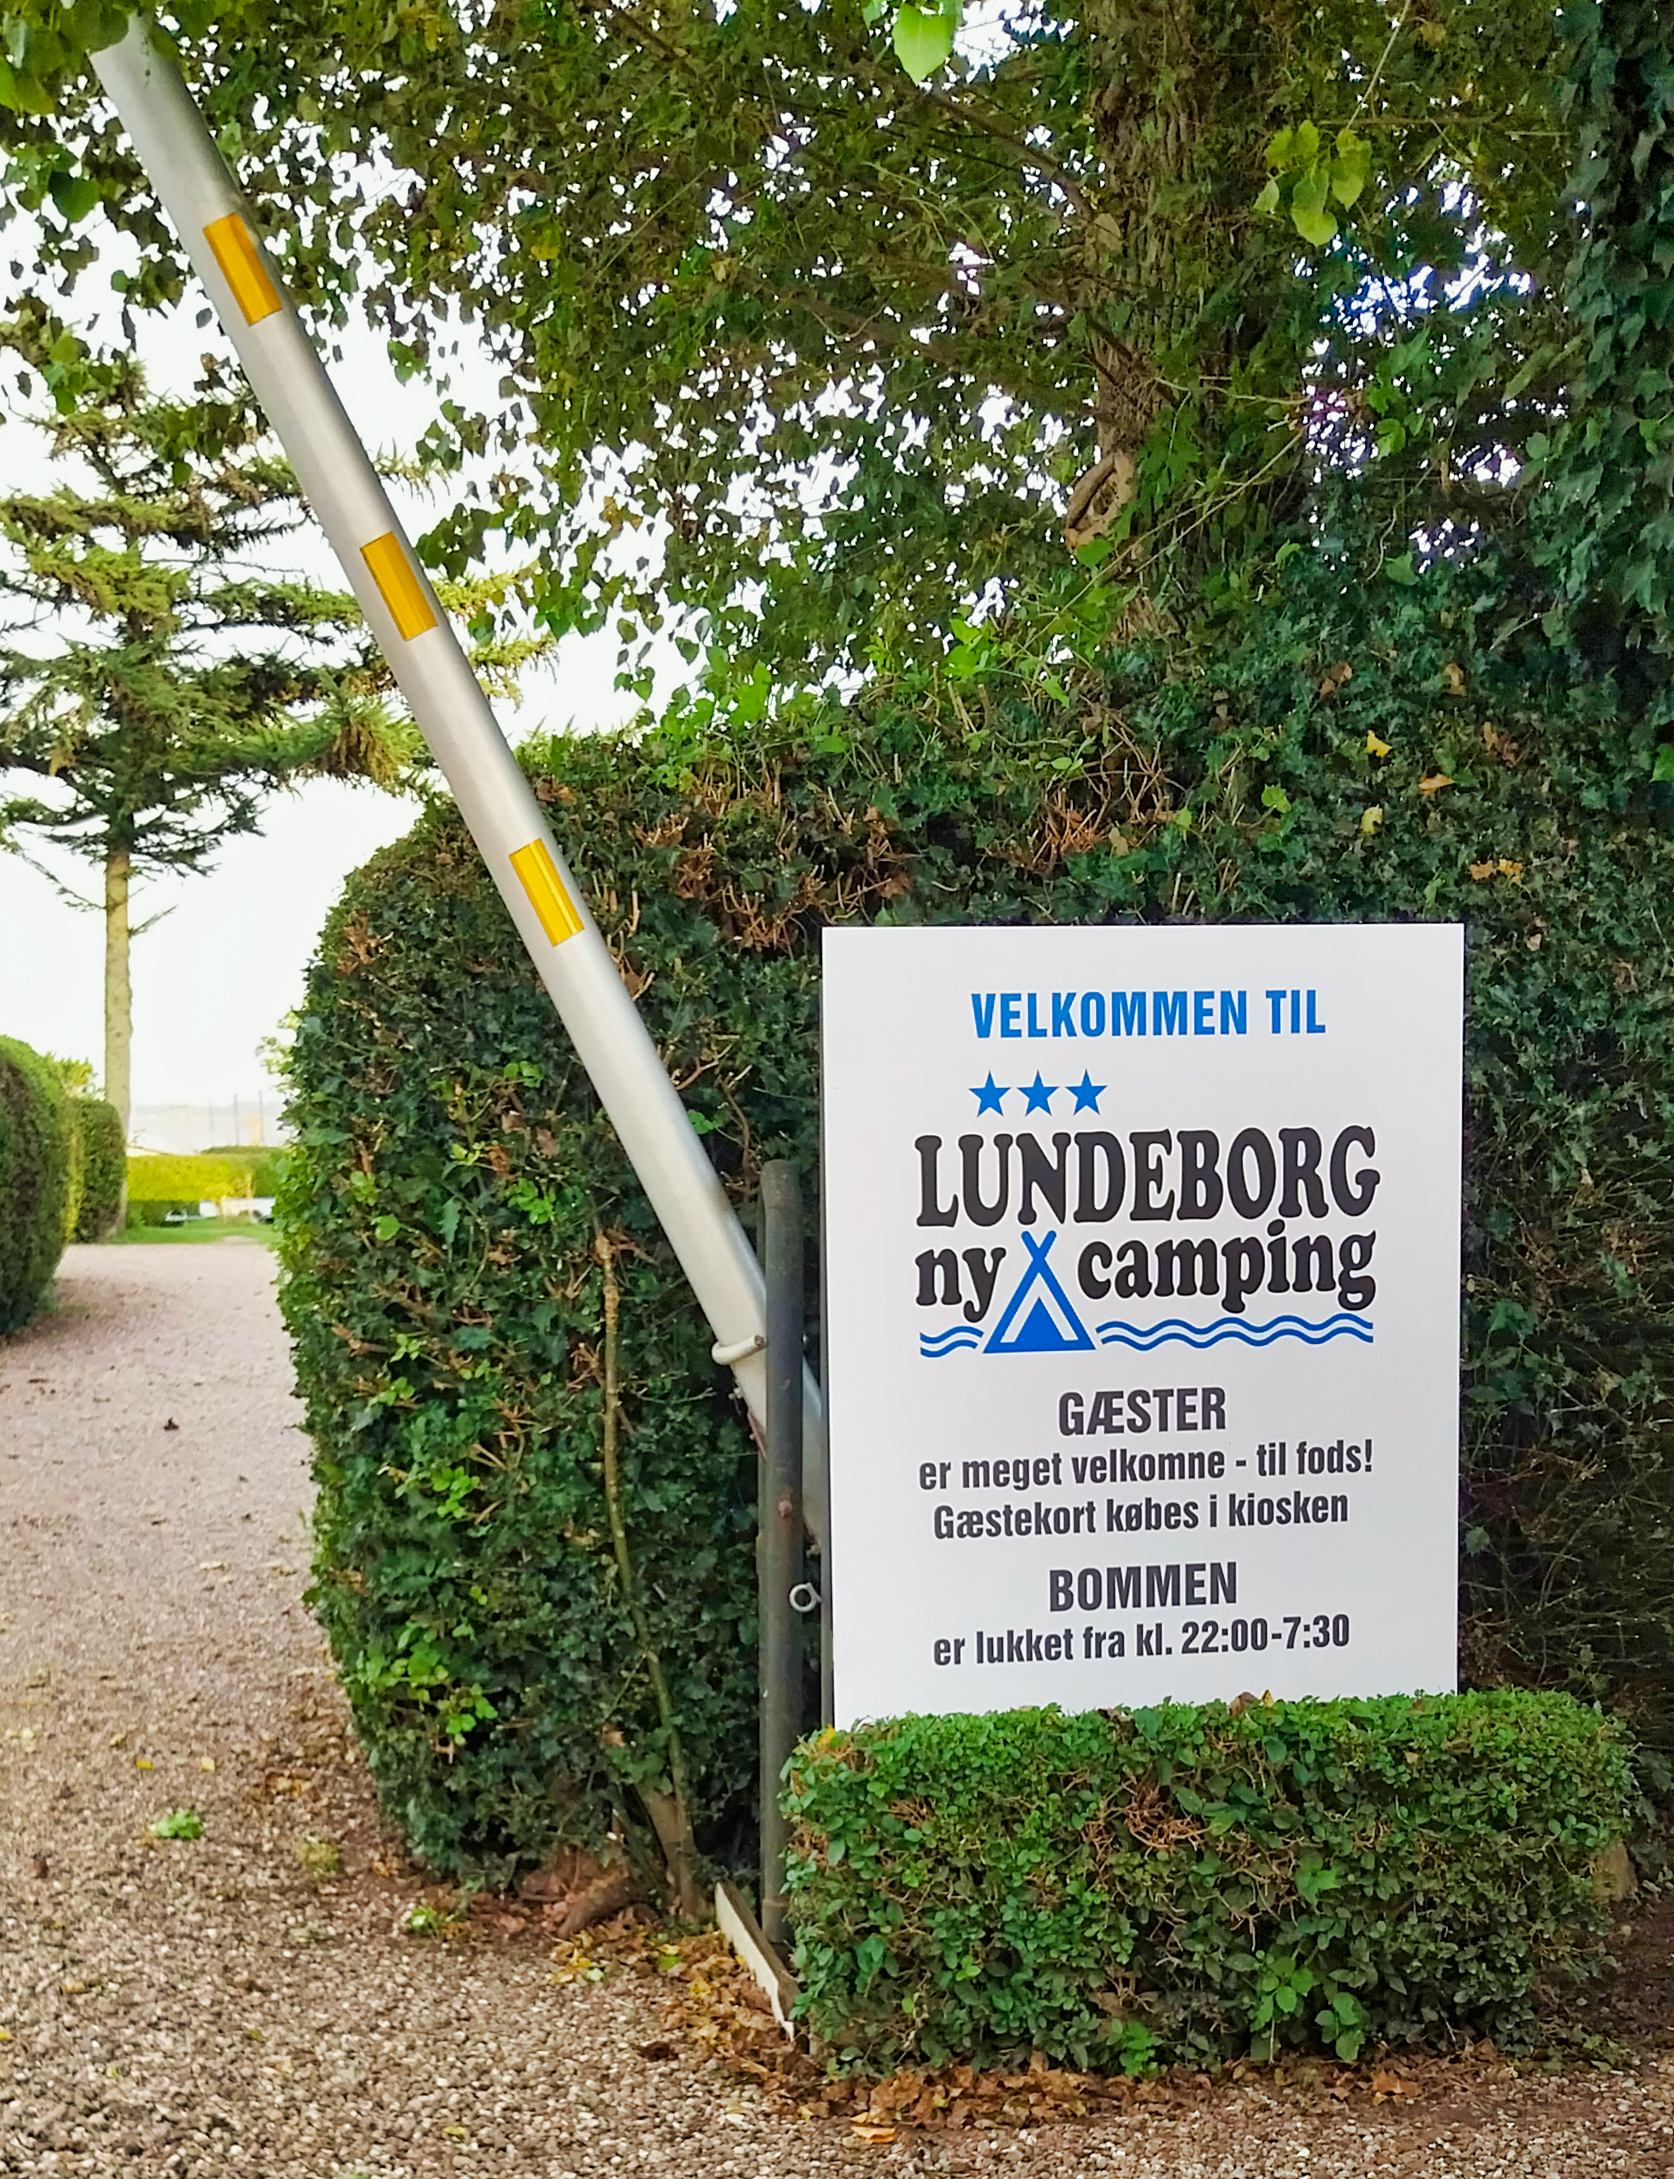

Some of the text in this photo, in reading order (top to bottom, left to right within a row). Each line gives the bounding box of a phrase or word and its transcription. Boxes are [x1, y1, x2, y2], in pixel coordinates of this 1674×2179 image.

[971, 990, 1325, 1038] VELKOMMEN TIL
[915, 1125, 1380, 1228] LUNDEBORG
[915, 1219, 1376, 1323] ny camping
[1059, 1387, 1225, 1436] GÆSTER
[920, 1462, 951, 1490] er
[963, 1453, 1062, 1490] meget
[1072, 1449, 1224, 1484] velkomne
[1257, 1442, 1286, 1476] til
[1297, 1439, 1372, 1474] fods!
[935, 1491, 1347, 1539] Gæstekort købes i kiosken
[1050, 1562, 1236, 1612] BOMMEN
[934, 1614, 1349, 1665] er lukket fra kl. 22:00-7:30
